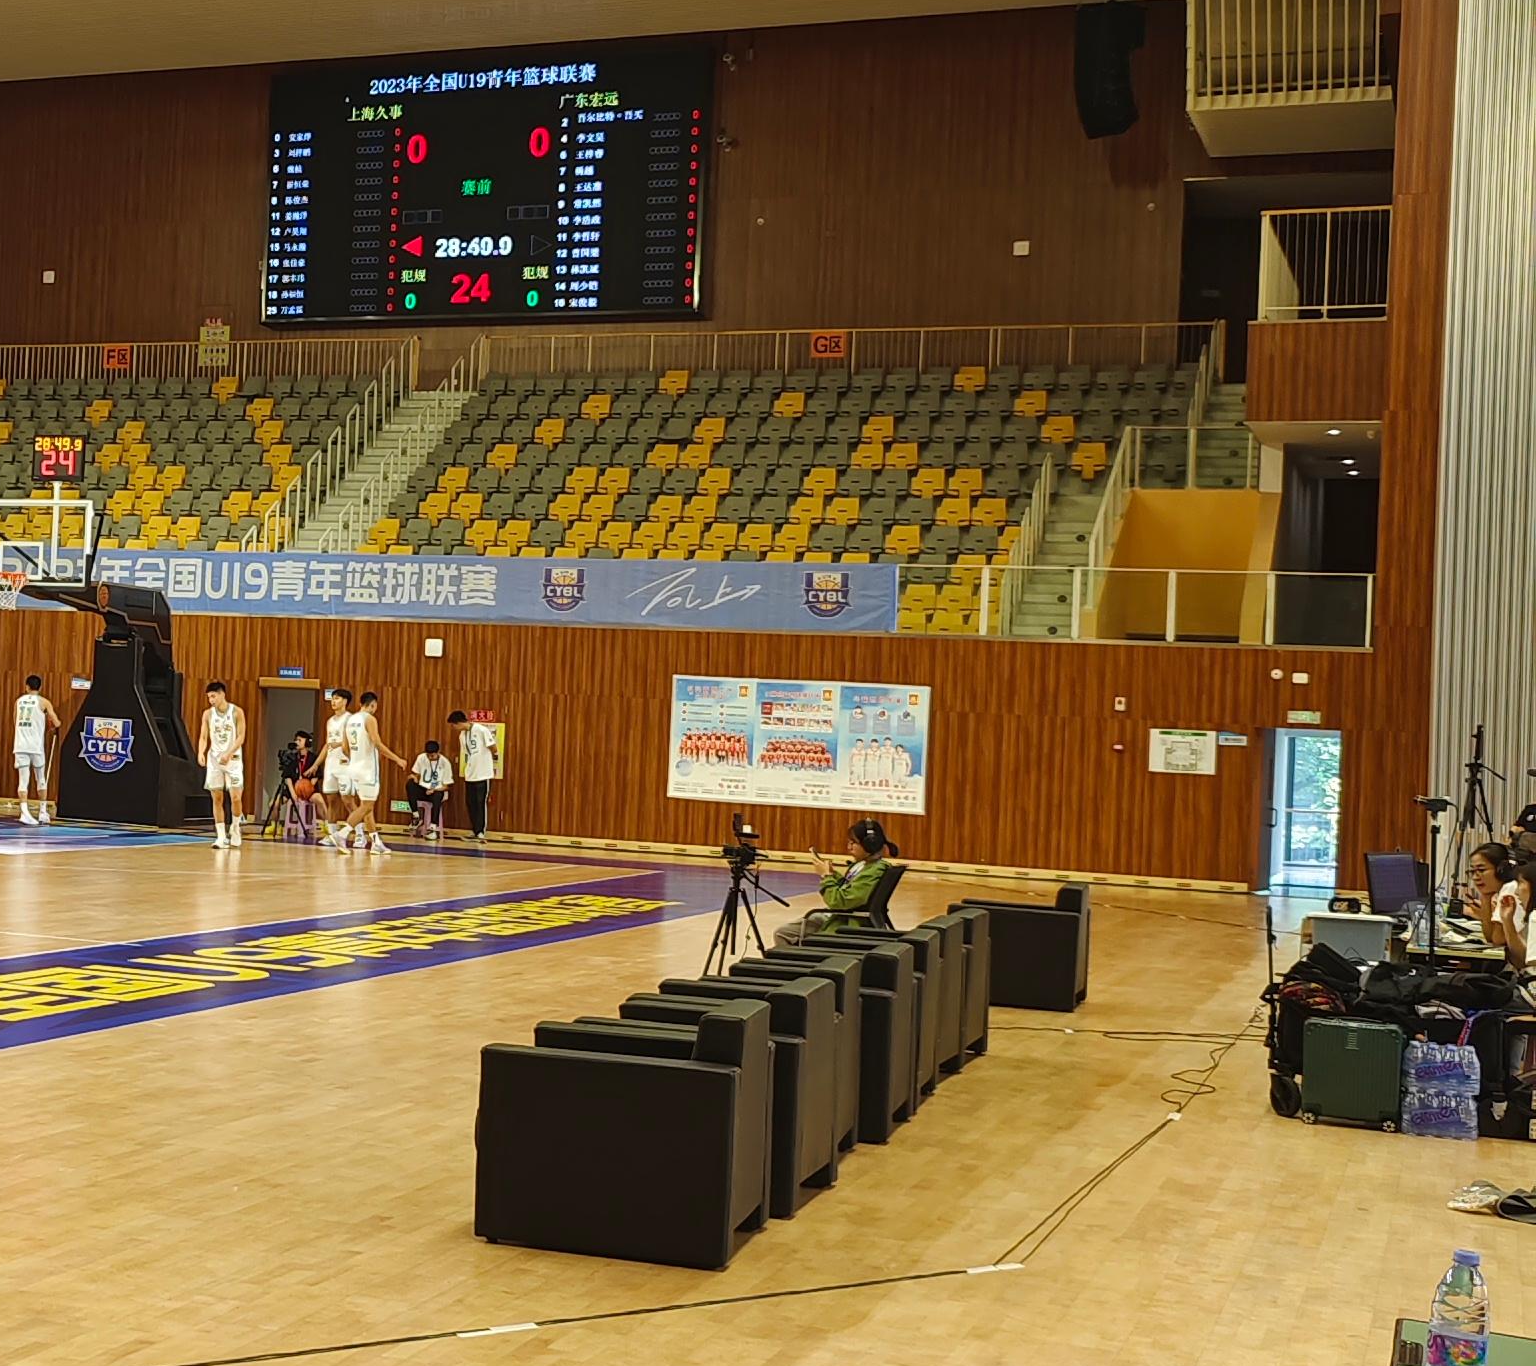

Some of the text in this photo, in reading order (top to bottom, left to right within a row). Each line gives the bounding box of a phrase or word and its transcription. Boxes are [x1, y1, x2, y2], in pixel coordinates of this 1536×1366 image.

[369, 63, 597, 95] 2023年全国U19青年篮球联赛
[559, 91, 619, 109] 广东宏远
[347, 105, 403, 122] 上海久事
[407, 134, 427, 164] 0
[529, 128, 549, 157] 0
[461, 178, 492, 196] 赛前
[401, 268, 426, 283] 犯规
[522, 265, 549, 280] 犯规
[450, 272, 491, 304] 24
[405, 293, 416, 309] 0
[526, 290, 539, 307] 0
[813, 335, 843, 354] G区
[106, 348, 130, 365] F区
[40, 450, 76, 476] 24
[546, 586, 581, 598] CYBL
[808, 590, 846, 603] CYBL
[86, 740, 127, 755] CYBL
